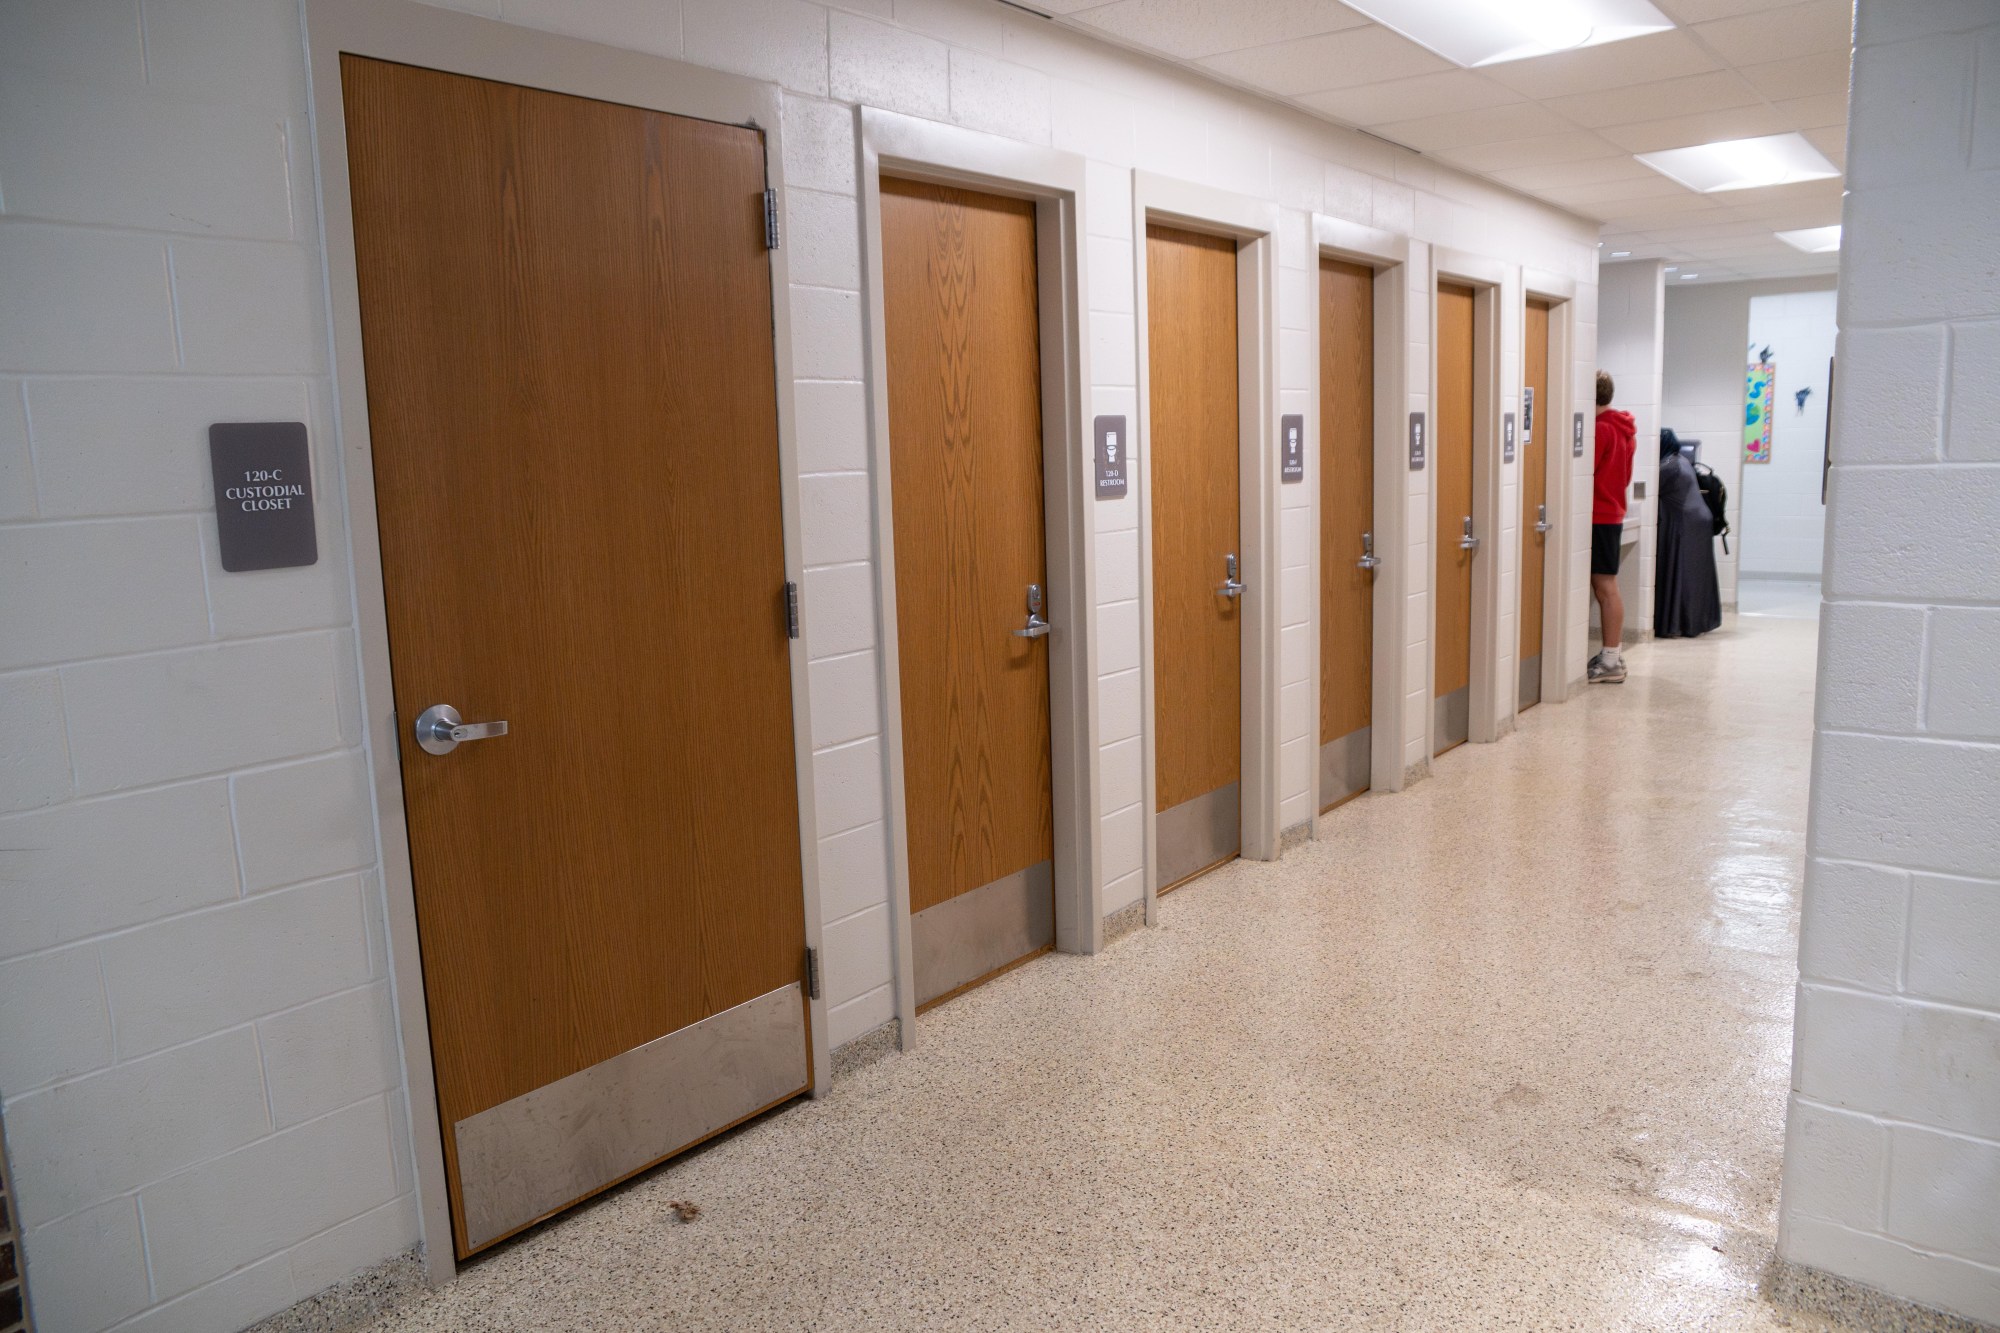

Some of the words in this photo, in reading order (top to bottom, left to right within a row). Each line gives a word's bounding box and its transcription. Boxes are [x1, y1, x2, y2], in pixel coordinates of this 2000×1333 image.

[243, 469, 283, 482] 120-C
[1099, 478, 1125, 487] RESTROOM
[225, 484, 305, 500] CUSTODIAL
[241, 497, 292, 512] CLOSET
